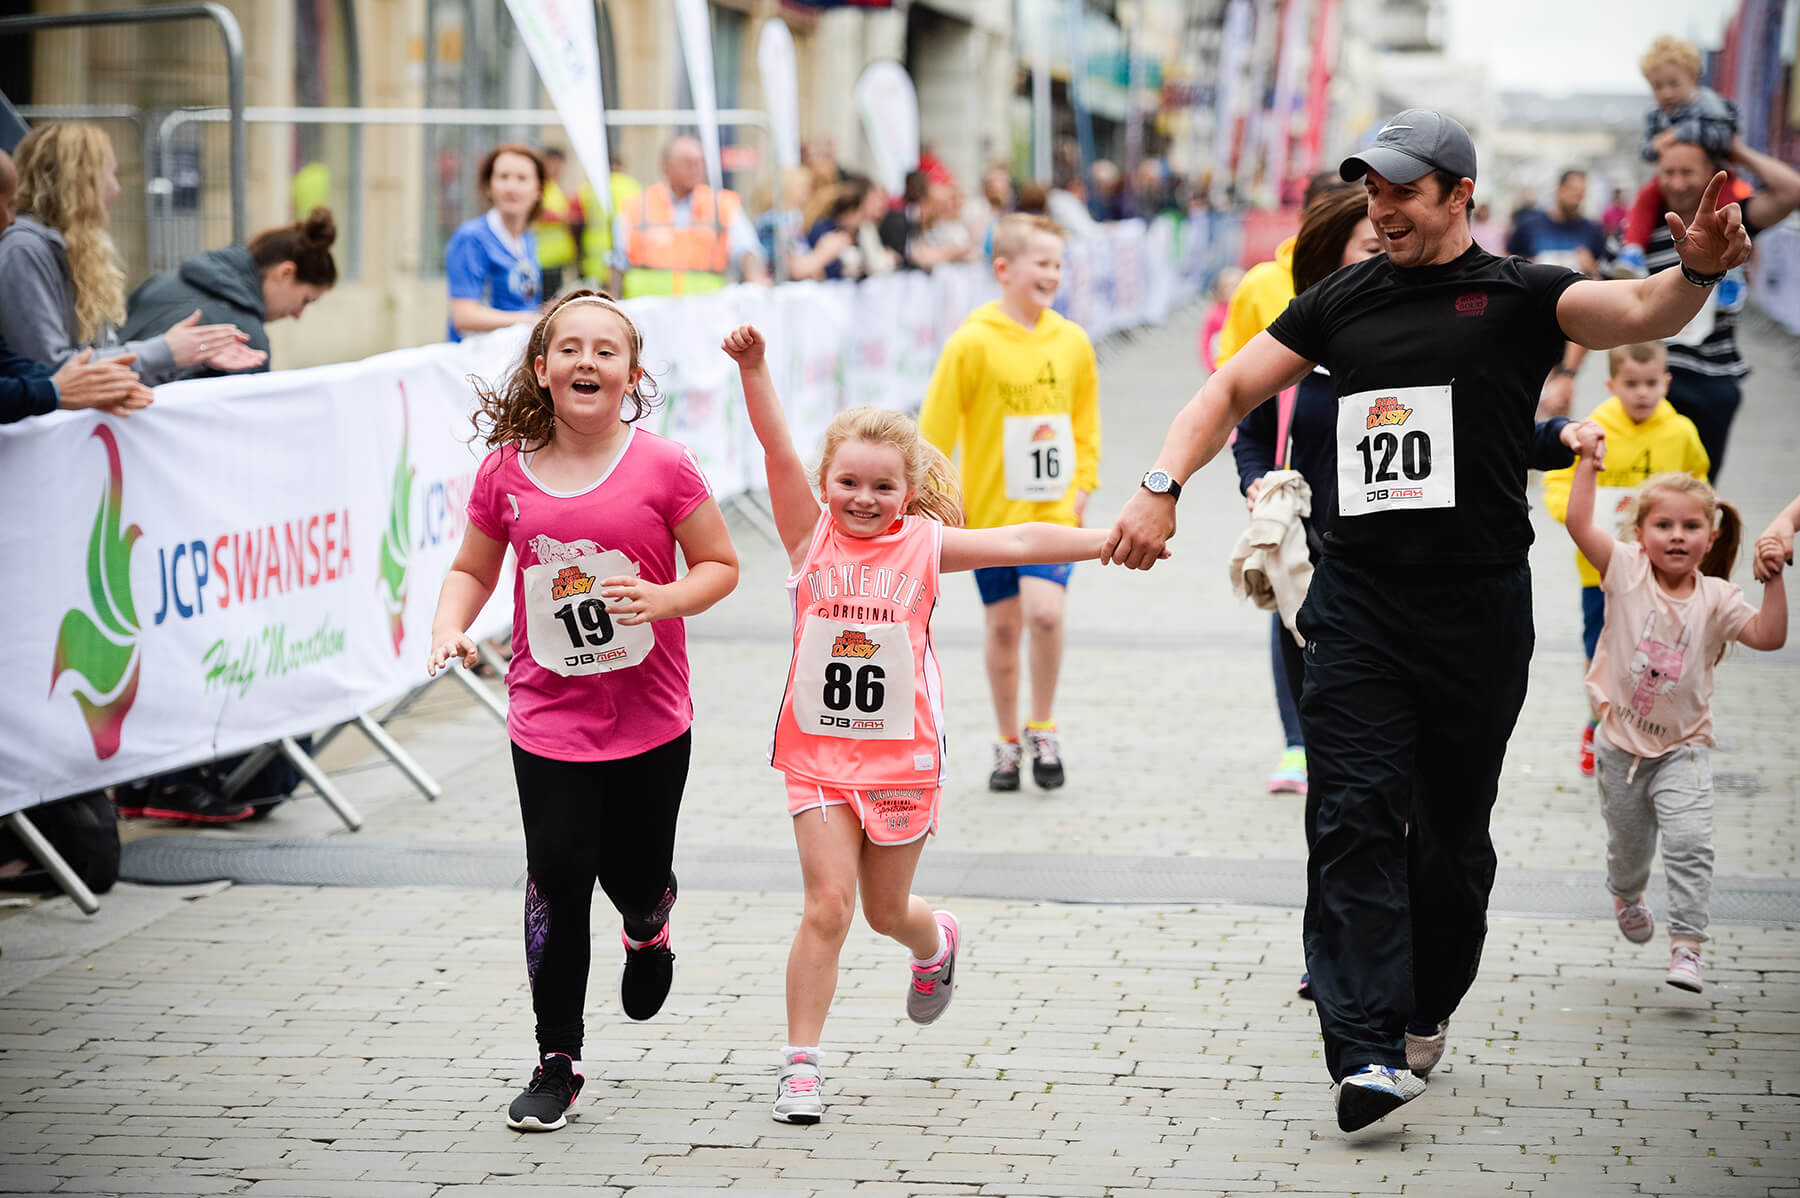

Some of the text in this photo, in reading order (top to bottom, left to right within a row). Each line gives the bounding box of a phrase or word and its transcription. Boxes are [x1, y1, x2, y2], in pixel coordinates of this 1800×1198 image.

[1367, 408, 1413, 430] DASH
[1031, 447, 1060, 479] 16
[1356, 430, 1432, 485] 120
[552, 576, 596, 600] DASH
[807, 563, 927, 614] MCKENZIE
[554, 598, 615, 649] 19
[832, 604, 896, 623] ORIGINAL
[201, 612, 346, 700] Half Marathon
[831, 644, 881, 660] DASH
[822, 662, 886, 713] 86
